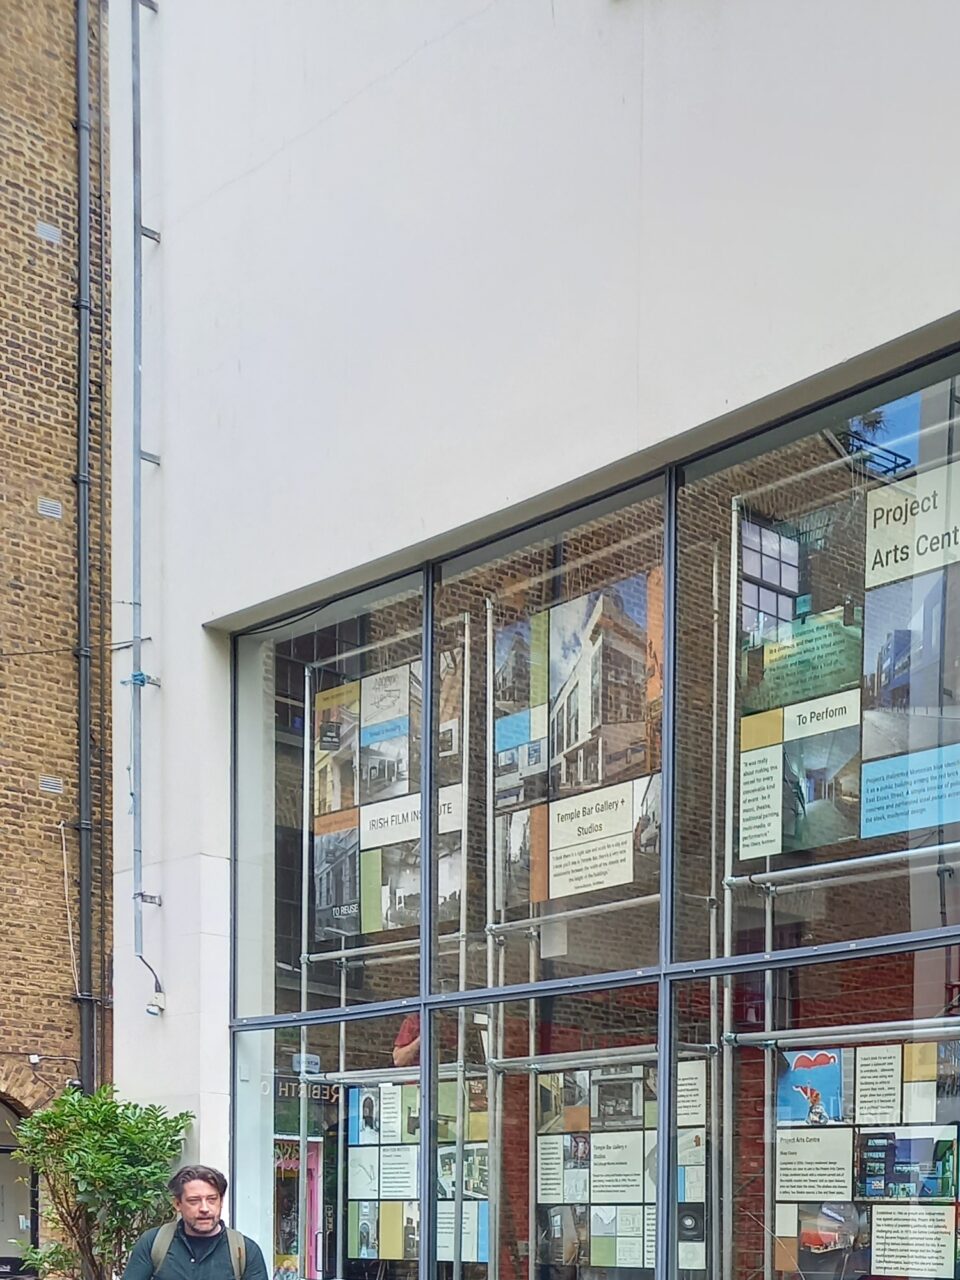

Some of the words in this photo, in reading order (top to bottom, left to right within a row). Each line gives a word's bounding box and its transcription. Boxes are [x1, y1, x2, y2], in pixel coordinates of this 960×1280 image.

[873, 490, 939, 529] Project
[872, 544, 909, 571] Arts
[796, 714, 807, 726] To
[809, 706, 847, 723] Perform
[369, 817, 389, 831] IRISH
[391, 812, 409, 826] FILM
[557, 810, 581, 823] Temple
[582, 806, 594, 817] Bar
[595, 800, 619, 813] Gallery
[577, 823, 603, 837] Studios
[332, 906, 340, 916] TO
[340, 903, 359, 914] REUSE
